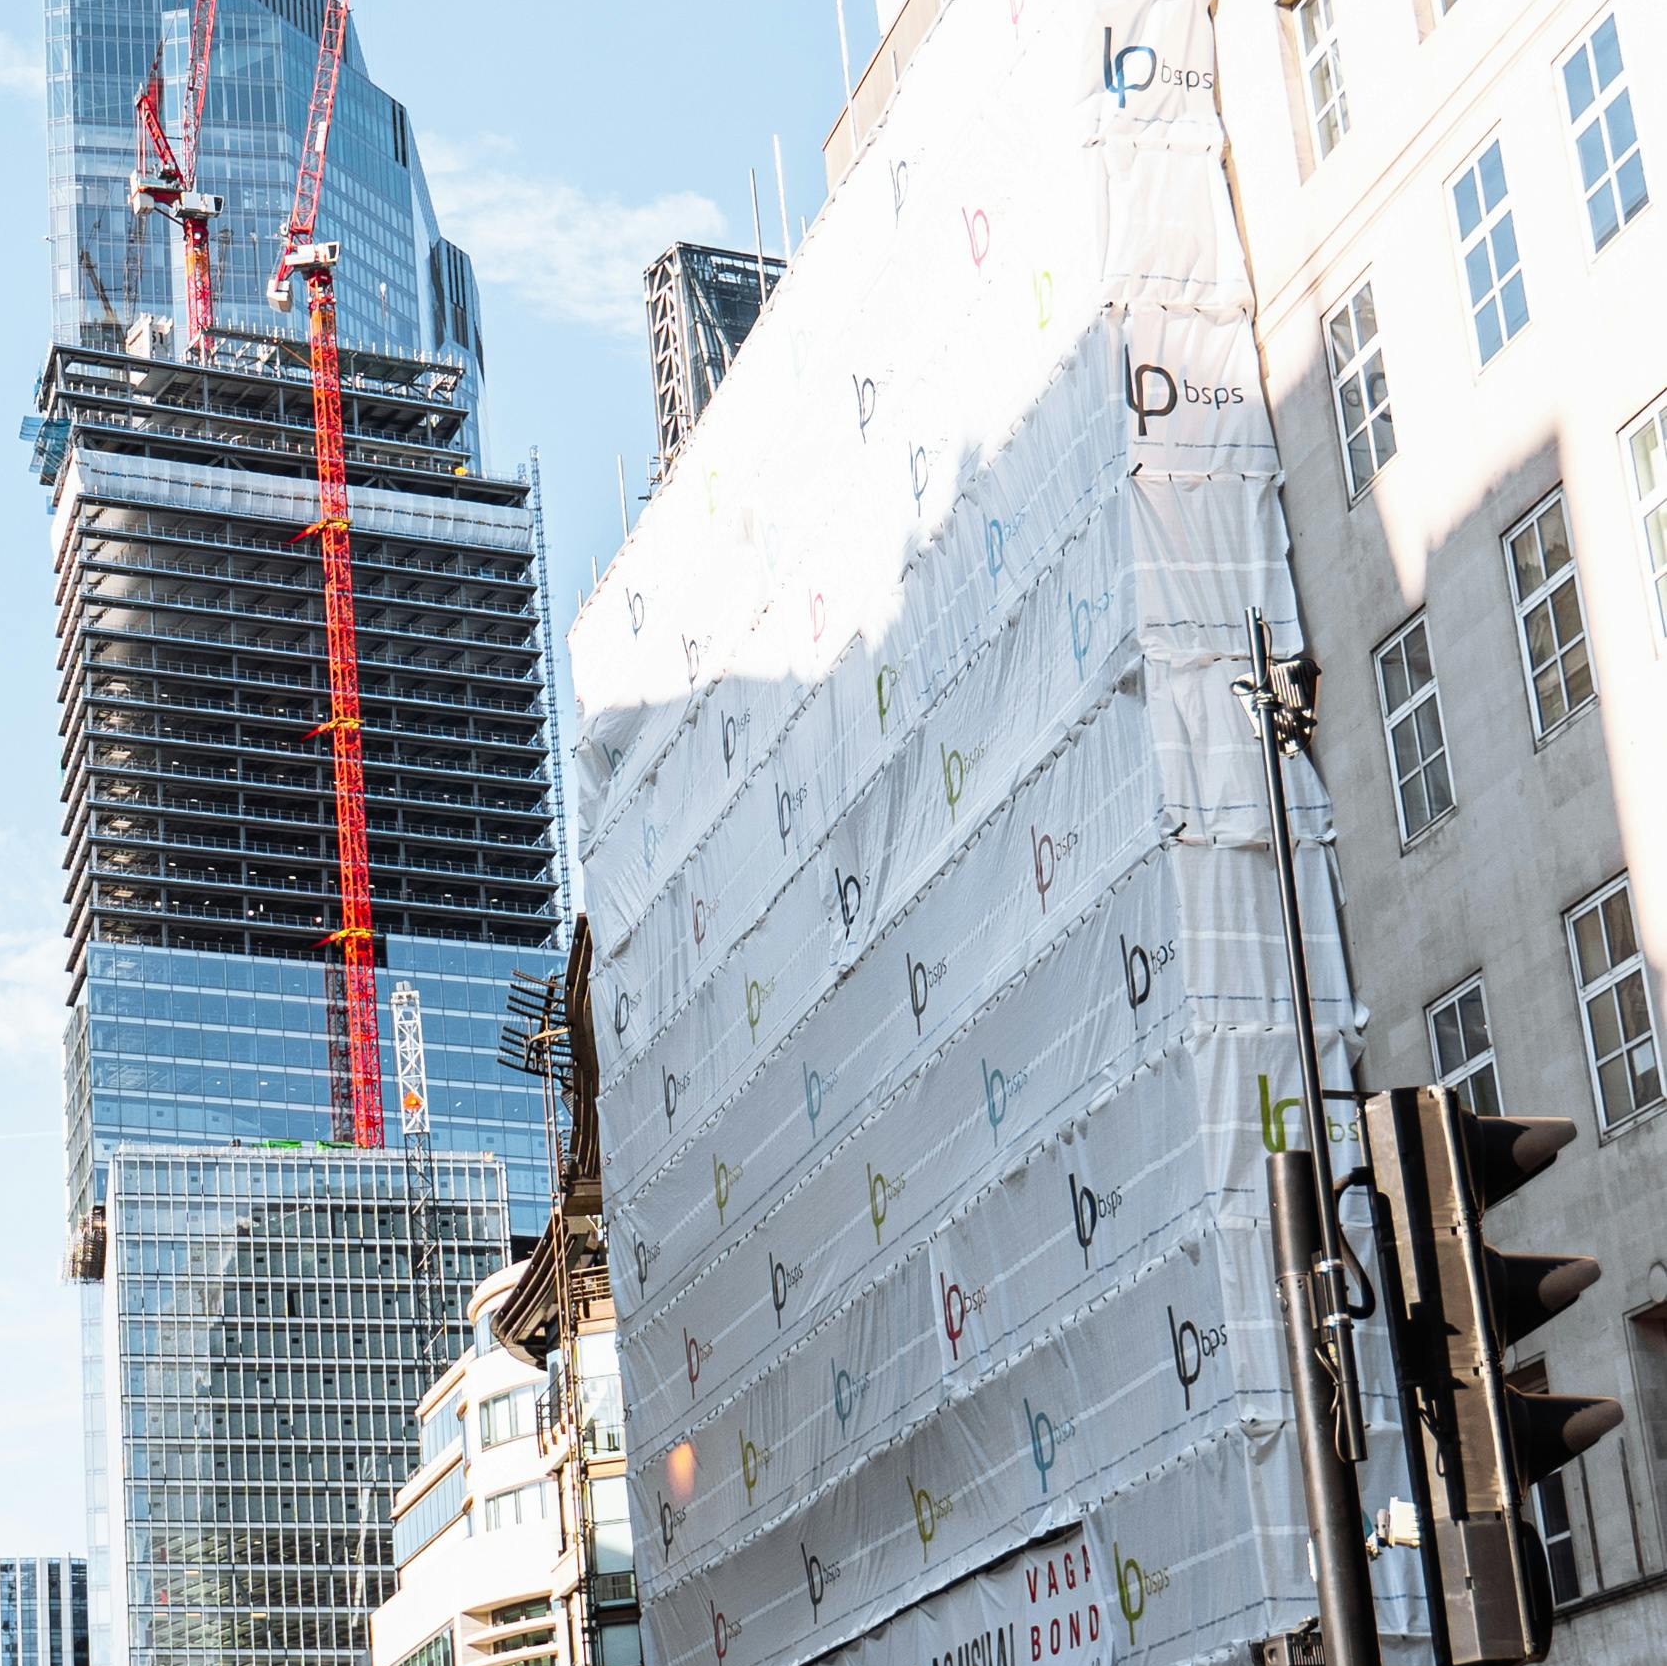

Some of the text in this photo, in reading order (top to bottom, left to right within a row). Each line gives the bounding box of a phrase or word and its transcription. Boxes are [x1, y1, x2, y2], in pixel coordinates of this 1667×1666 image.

[1183, 379, 1244, 410] bsps
[1097, 1185, 1123, 1220] bsps
[787, 1264, 804, 1290] bsps
[963, 1282, 988, 1316] bsps
[1144, 1564, 1171, 1598] bsps
[1030, 1604, 1101, 1662] BOND
